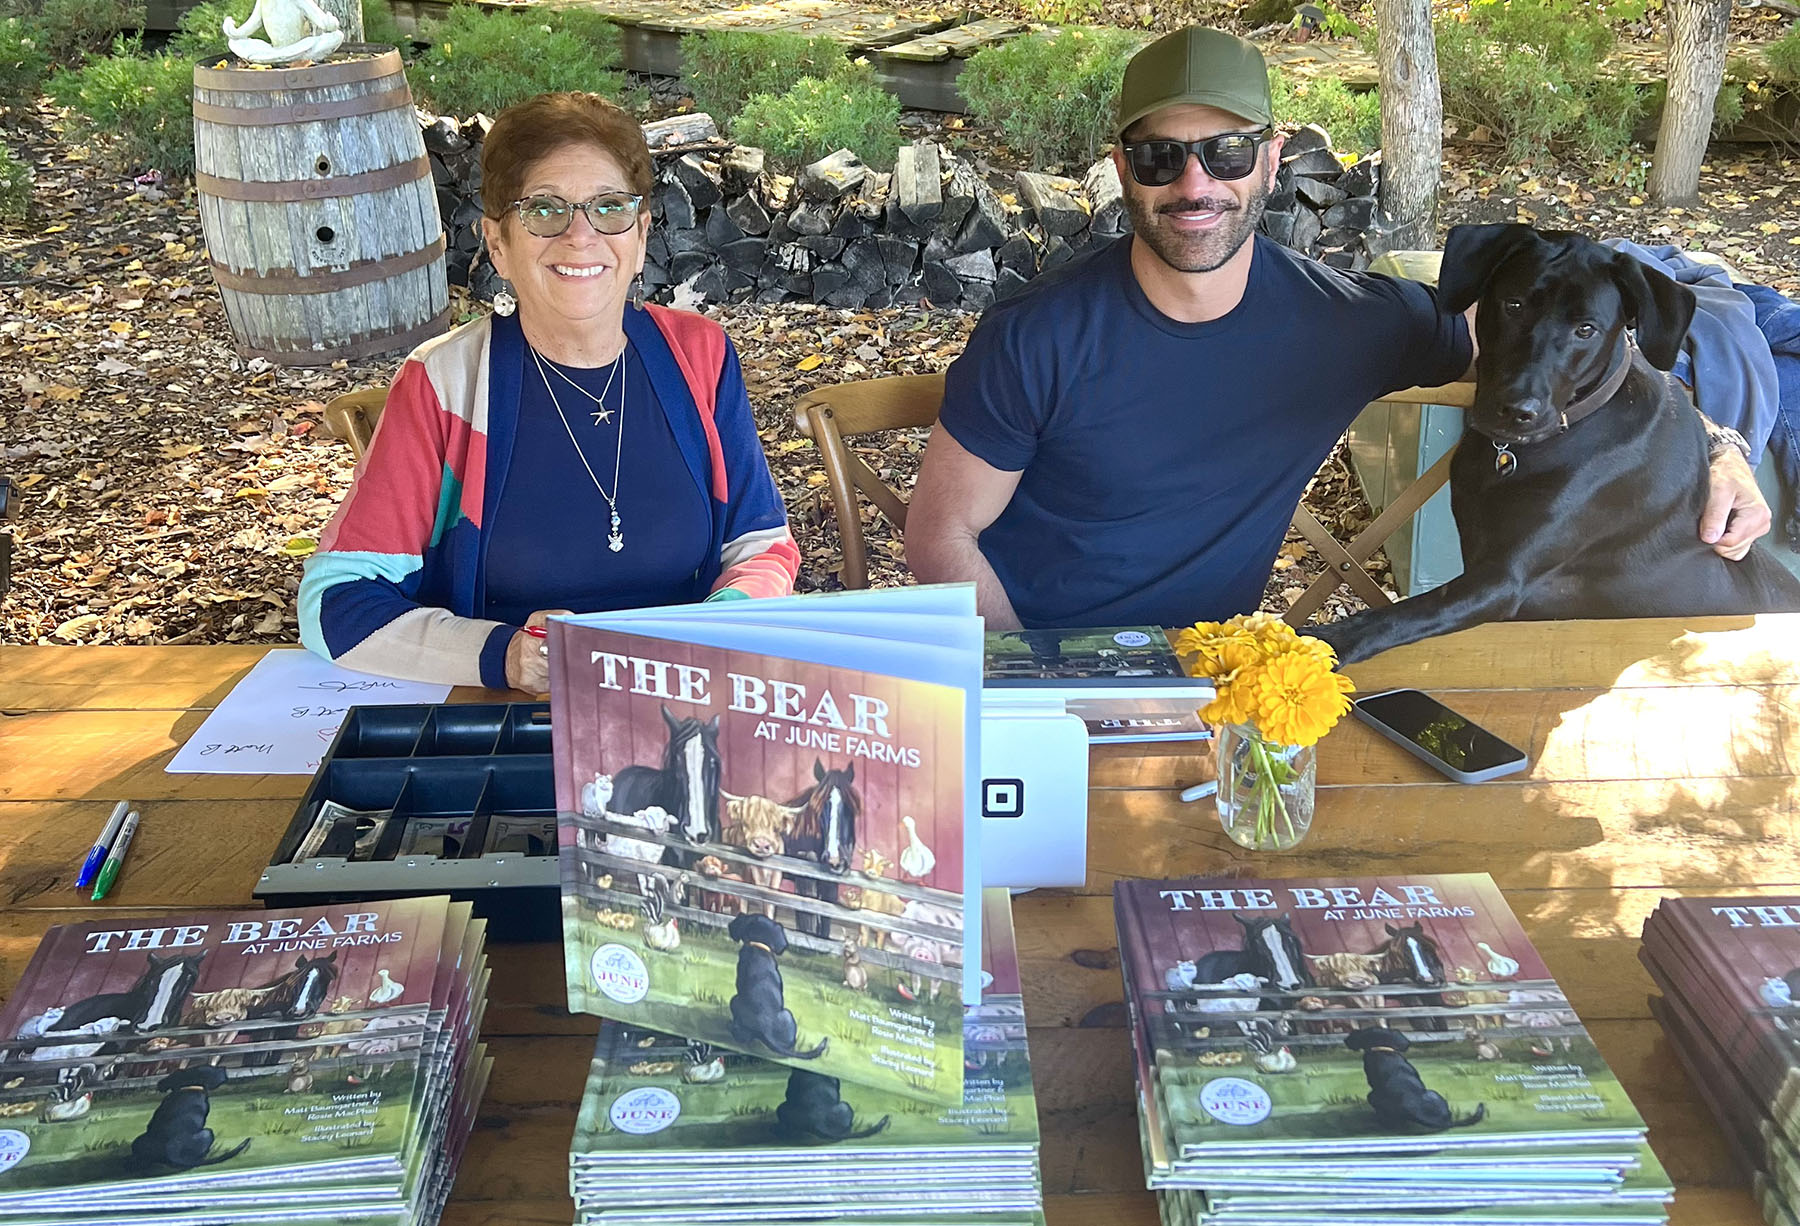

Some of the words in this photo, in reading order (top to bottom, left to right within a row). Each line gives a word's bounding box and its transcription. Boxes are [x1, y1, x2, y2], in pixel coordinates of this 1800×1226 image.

[591, 651, 711, 706] THE
[728, 673, 892, 738] BEAR
[753, 720, 781, 740] AT
[785, 727, 840, 753] JUNE
[845, 737, 921, 768] FARMS
[1159, 887, 1277, 912] THE
[1287, 885, 1441, 910] BEAR
[1323, 907, 1346, 921] AT
[1352, 906, 1400, 921] JUNE
[1406, 904, 1475, 920] FARMS
[85, 924, 209, 954] THE
[221, 911, 380, 945] BEAR
[241, 944, 270, 955] AT
[272, 938, 328, 954] JUNE
[331, 931, 403, 949] FARMS
[598, 970, 644, 991] JUNE
[849, 1009, 870, 1023] Matt
[872, 1015, 926, 1036] Baumgartner
[889, 1007, 922, 1024] Written
[923, 1016, 935, 1028] by
[871, 1026, 895, 1040] Rosie
[895, 1031, 935, 1049] MacPhail
[332, 1092, 368, 1103] Written
[369, 1090, 382, 1099] by
[1210, 1100, 1266, 1111] JUNE
[284, 1107, 308, 1116] Matt
[335, 1106, 378, 1118] MacPhail
[617, 1108, 673, 1120] JUNE
